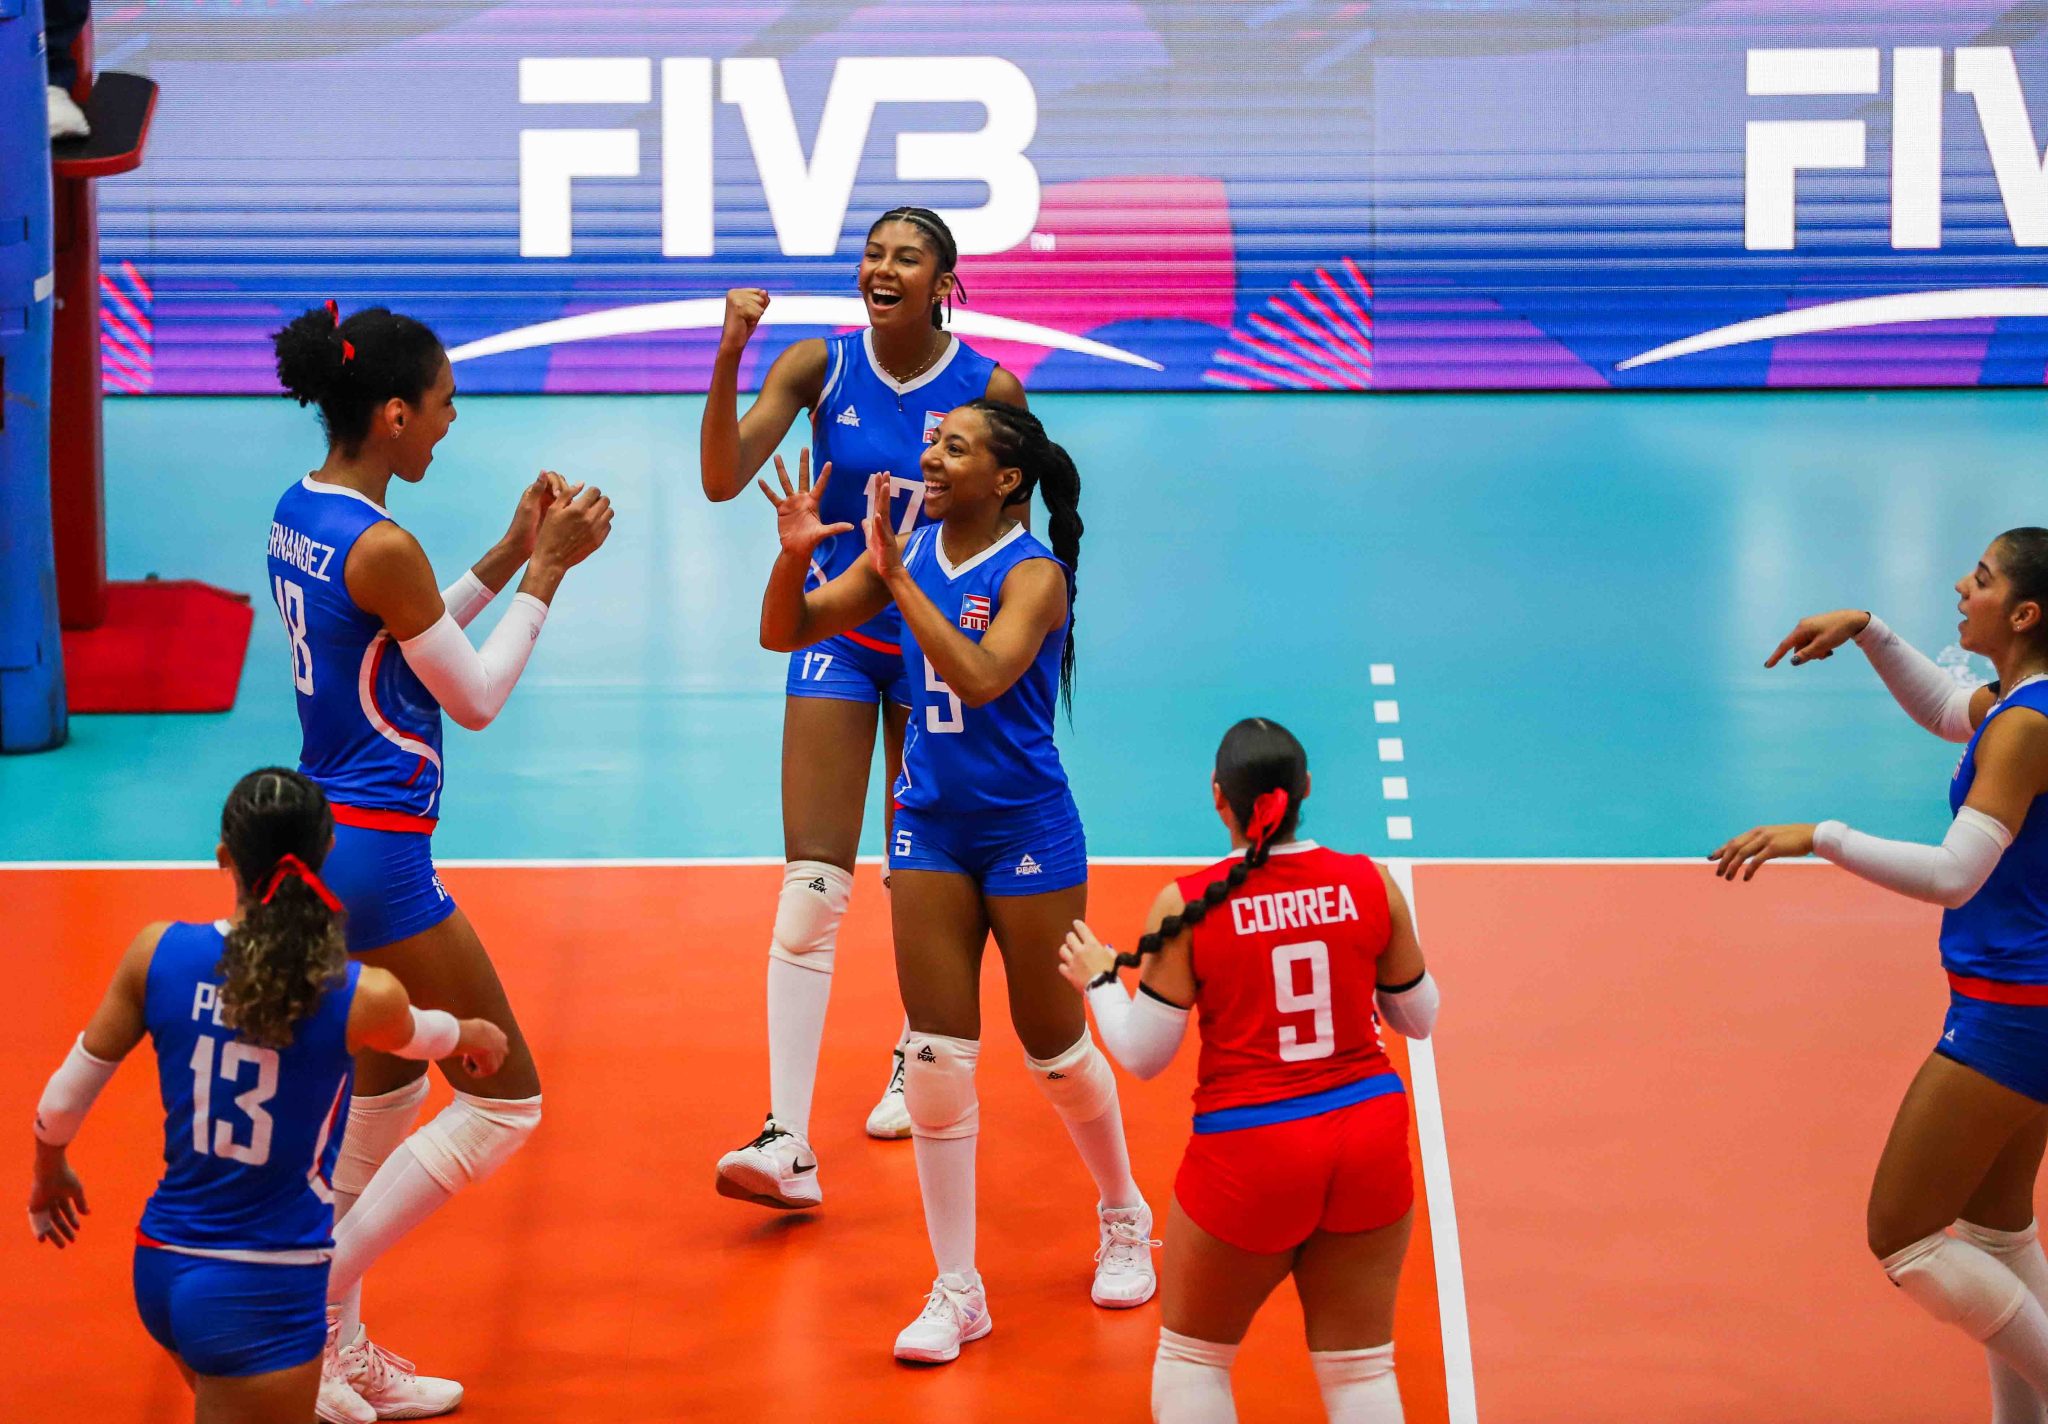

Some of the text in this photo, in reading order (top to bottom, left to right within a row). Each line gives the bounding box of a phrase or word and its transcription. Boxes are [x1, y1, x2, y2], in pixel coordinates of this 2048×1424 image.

[519, 57, 1040, 257] FIVB
[836, 414, 861, 427] PEAK
[267, 521, 336, 583] RNANDEZ
[275, 575, 314, 696] 18
[961, 617, 988, 631] PUR
[801, 651, 834, 681] 17
[924, 654, 964, 733] 5
[894, 829, 912, 856] 5
[809, 882, 827, 894] PEAK
[1015, 863, 1043, 875] PEAK
[1231, 884, 1359, 935] CORREA
[1271, 940, 1335, 1062] 9
[917, 1052, 936, 1063] PEAK
[189, 1034, 280, 1166] 13
